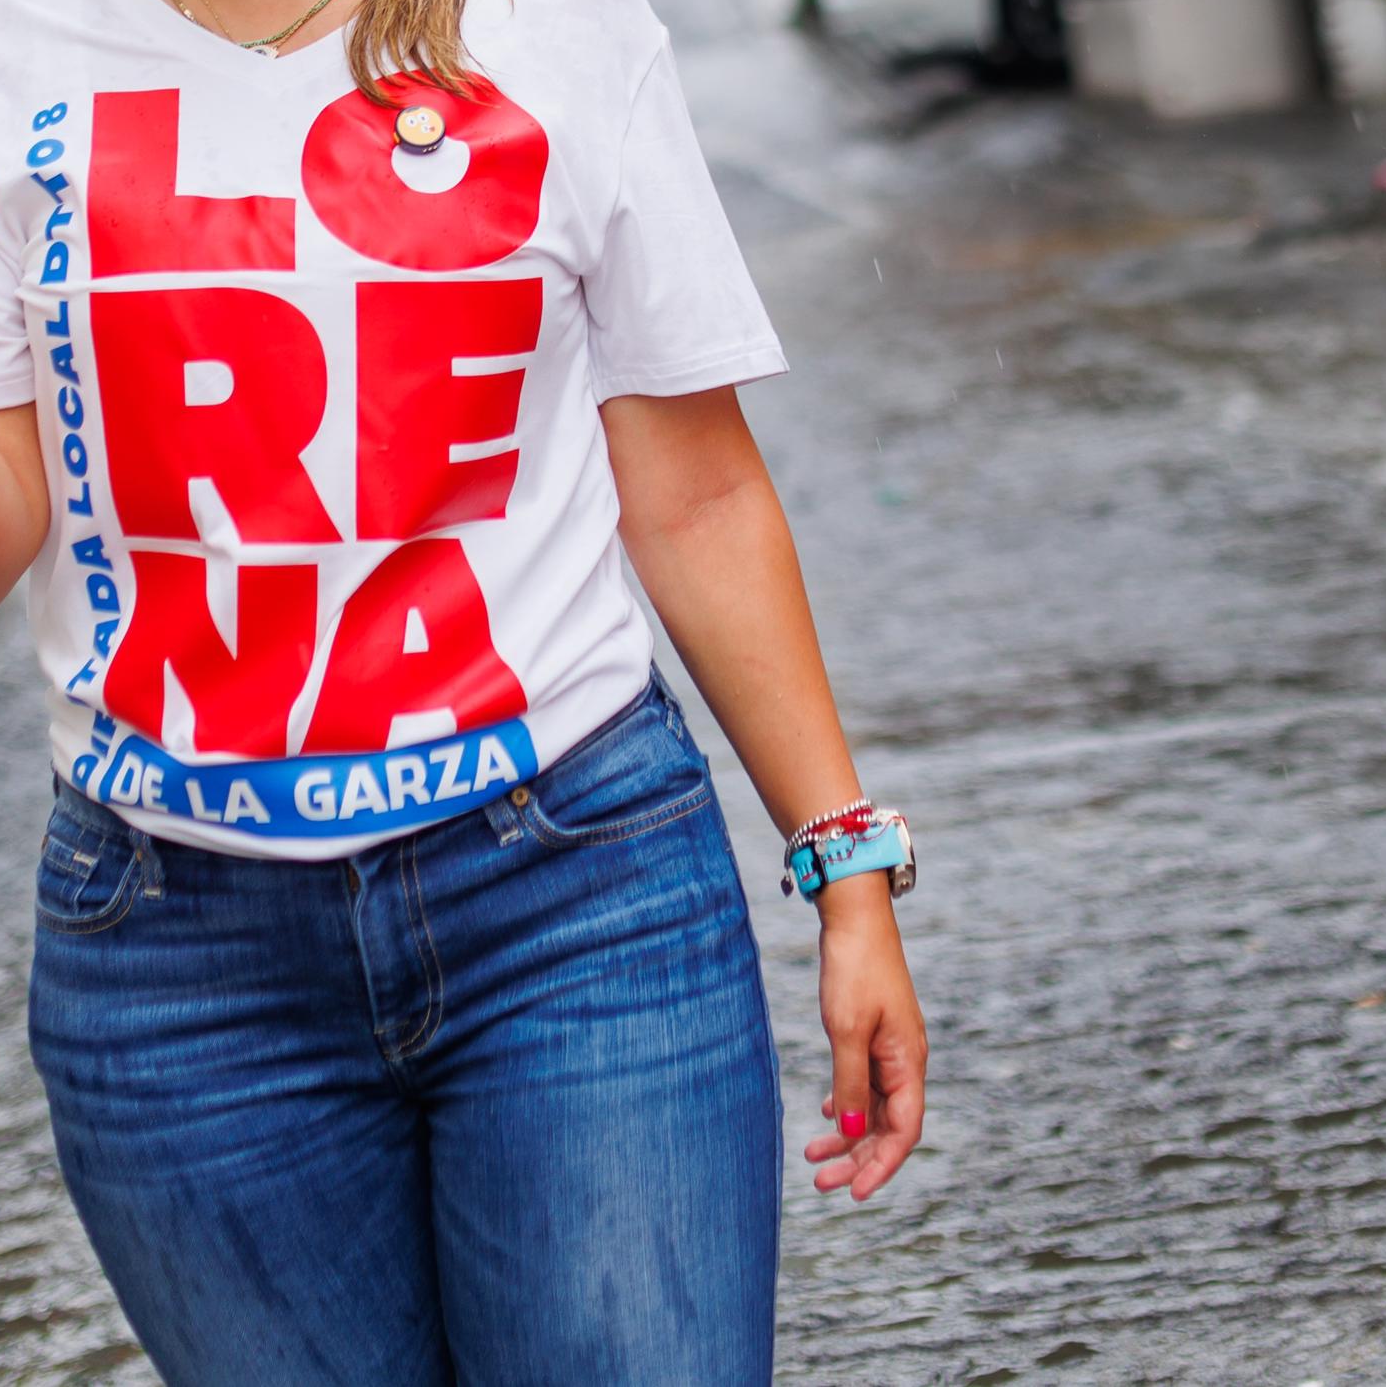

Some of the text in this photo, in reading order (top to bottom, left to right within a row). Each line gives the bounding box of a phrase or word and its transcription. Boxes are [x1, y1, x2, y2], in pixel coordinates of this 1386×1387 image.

[88, 68, 549, 278] LO
[45, 301, 93, 518] LOCAL
[89, 277, 544, 544] RE
[65, 534, 122, 793] DIPTADA
[104, 538, 529, 759] NA
[110, 734, 520, 824] DE LA GARZA
